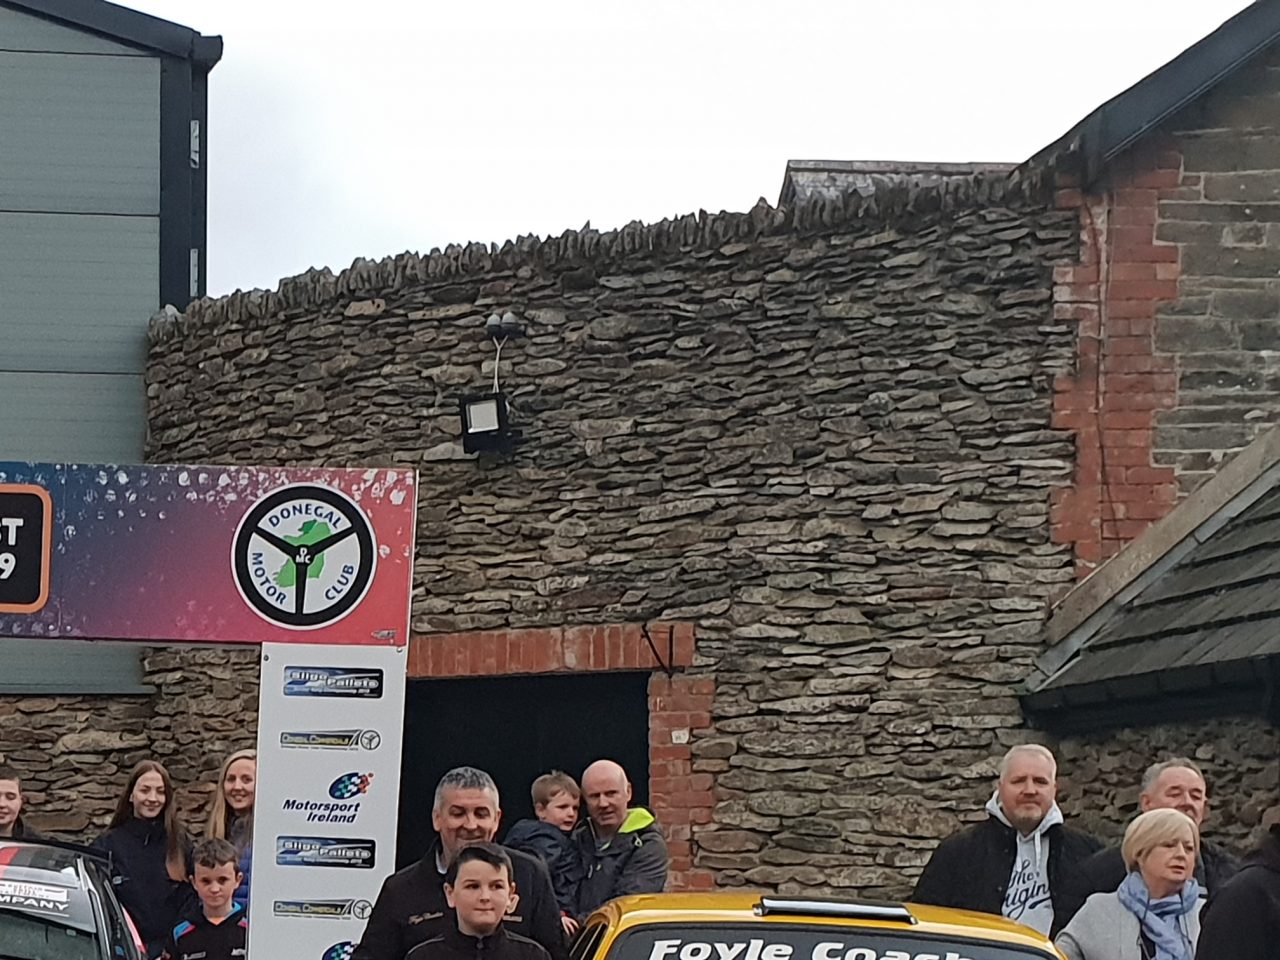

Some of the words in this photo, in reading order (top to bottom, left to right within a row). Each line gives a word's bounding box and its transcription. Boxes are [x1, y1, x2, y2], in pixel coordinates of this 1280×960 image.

[268, 503, 343, 529] DONEGAL
[252, 552, 287, 605] MOTOR
[324, 565, 354, 600] CLUB
[283, 799, 361, 815] Motorsport
[307, 809, 357, 824] Ireland
